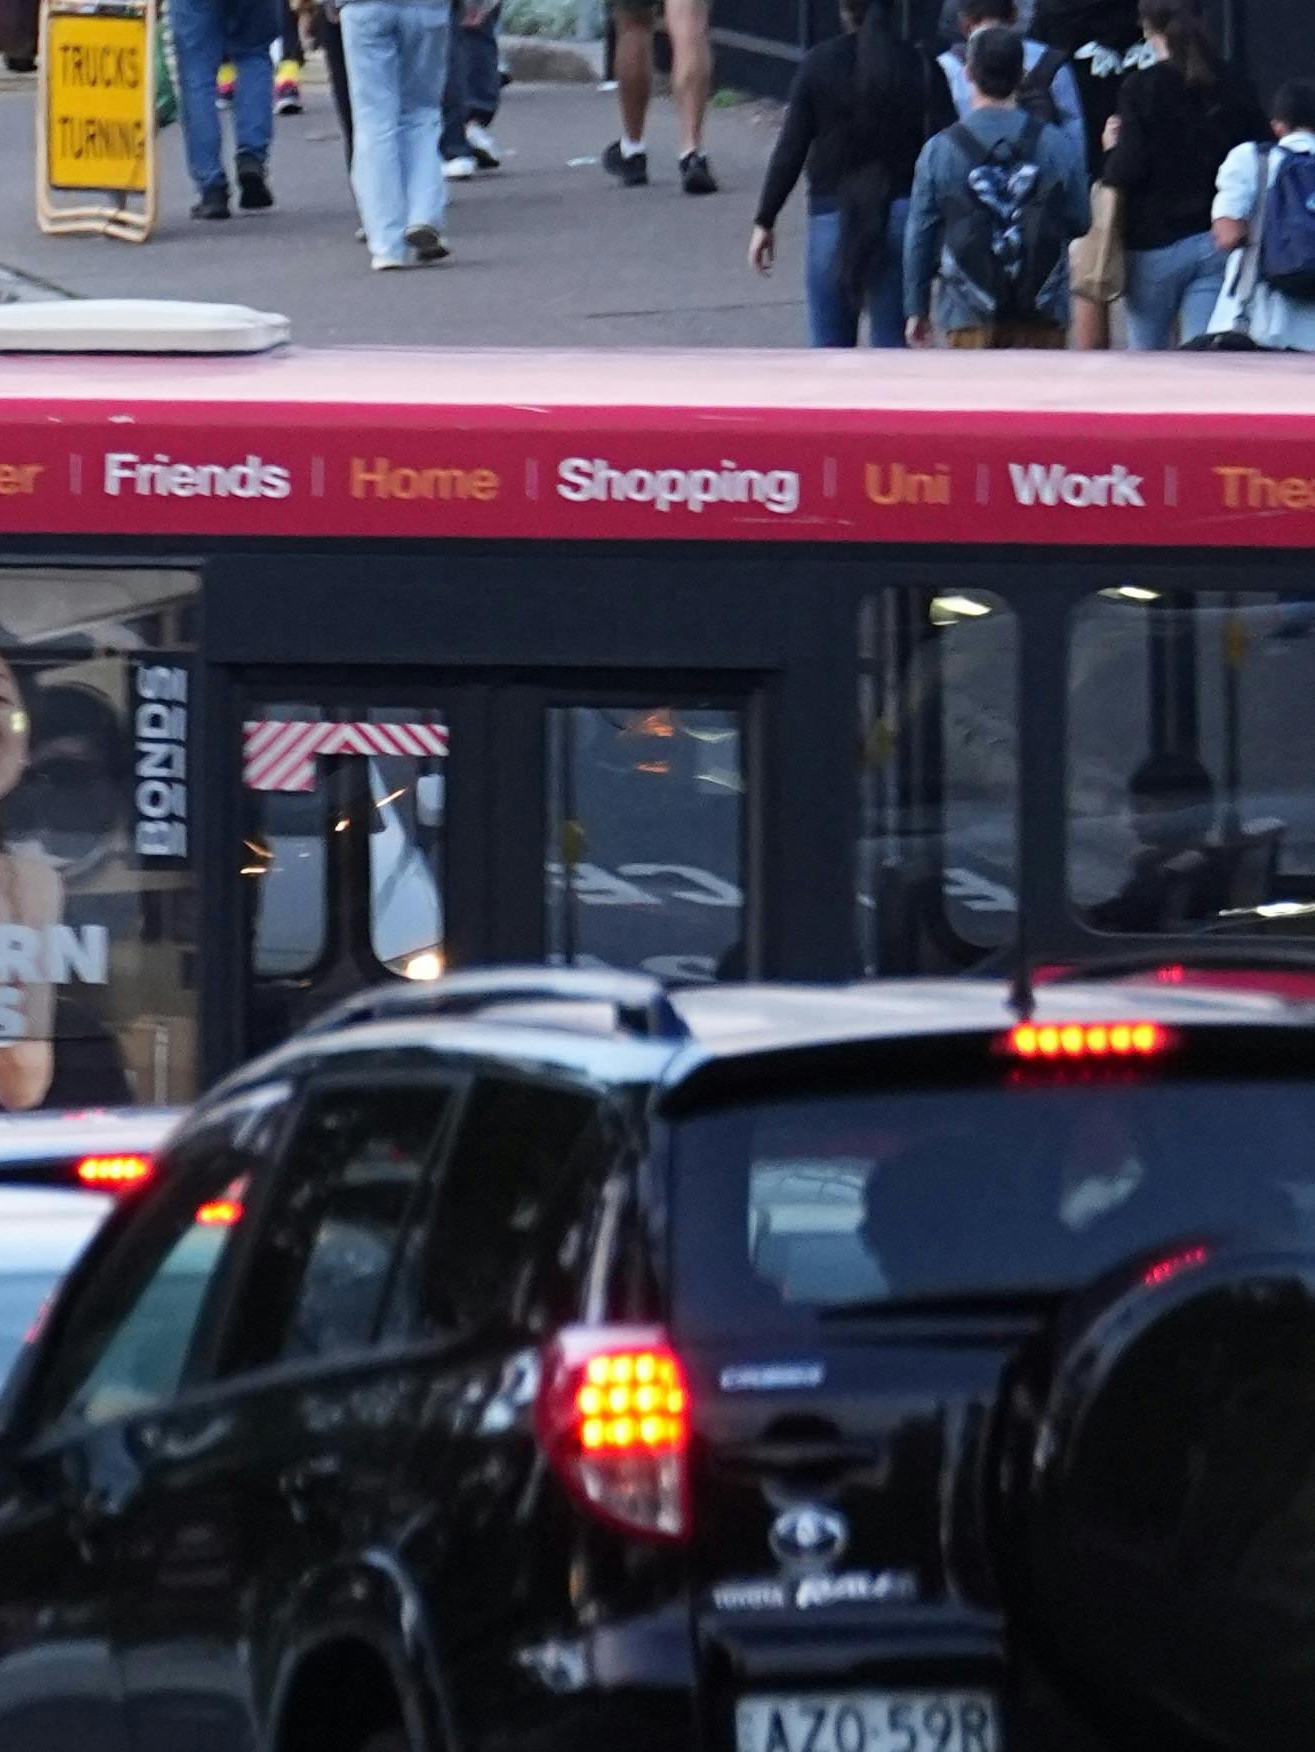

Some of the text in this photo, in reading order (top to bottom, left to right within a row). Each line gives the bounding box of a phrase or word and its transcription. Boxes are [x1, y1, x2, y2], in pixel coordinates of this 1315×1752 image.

[59, 43, 139, 89] TRUCKS
[59, 117, 145, 161] TURNING
[104, 453, 291, 499] Friends
[351, 457, 499, 502] Home
[557, 457, 800, 515] Shopping
[865, 461, 949, 507] Uni
[1009, 462, 1145, 508] Work
[135, 664, 189, 858] BONDS
